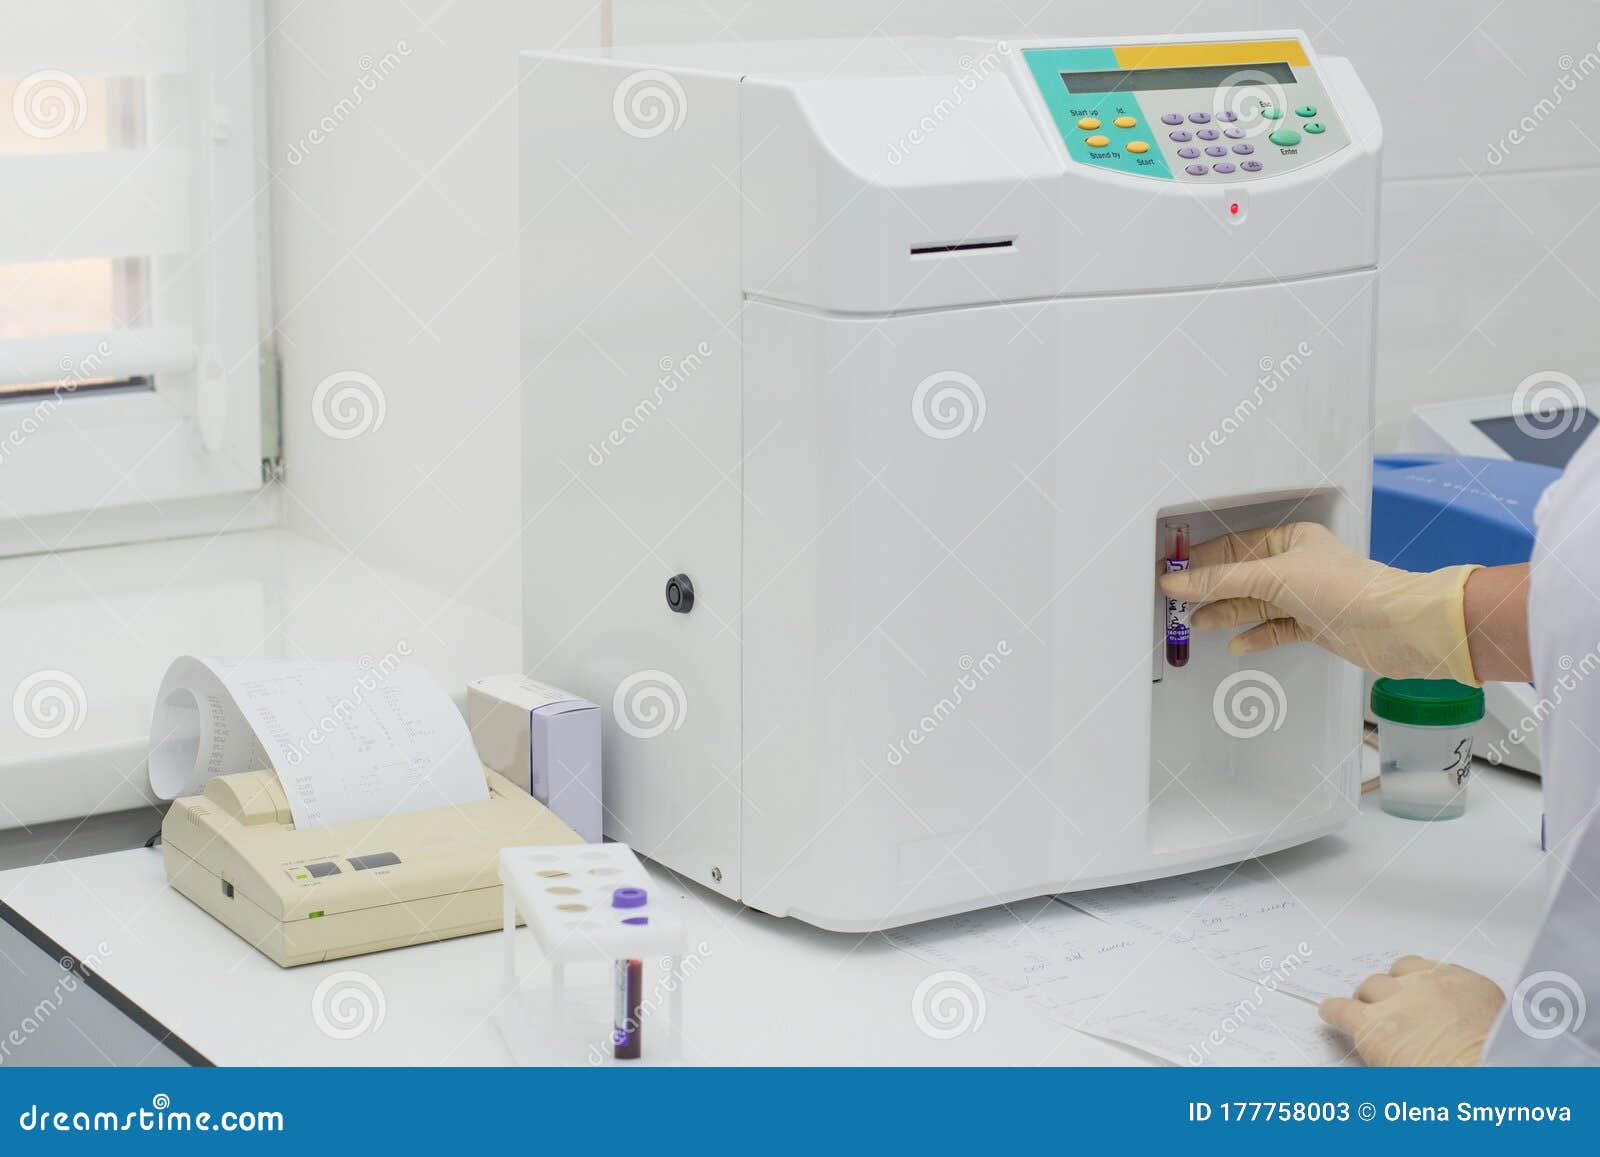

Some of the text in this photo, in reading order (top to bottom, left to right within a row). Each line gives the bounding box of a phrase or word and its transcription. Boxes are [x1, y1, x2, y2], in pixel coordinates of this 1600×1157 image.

[1070, 109, 1089, 117] Start
[1280, 147, 1298, 155] Enter
[1089, 151, 1111, 160] Stand
[1136, 158, 1155, 166] Start
